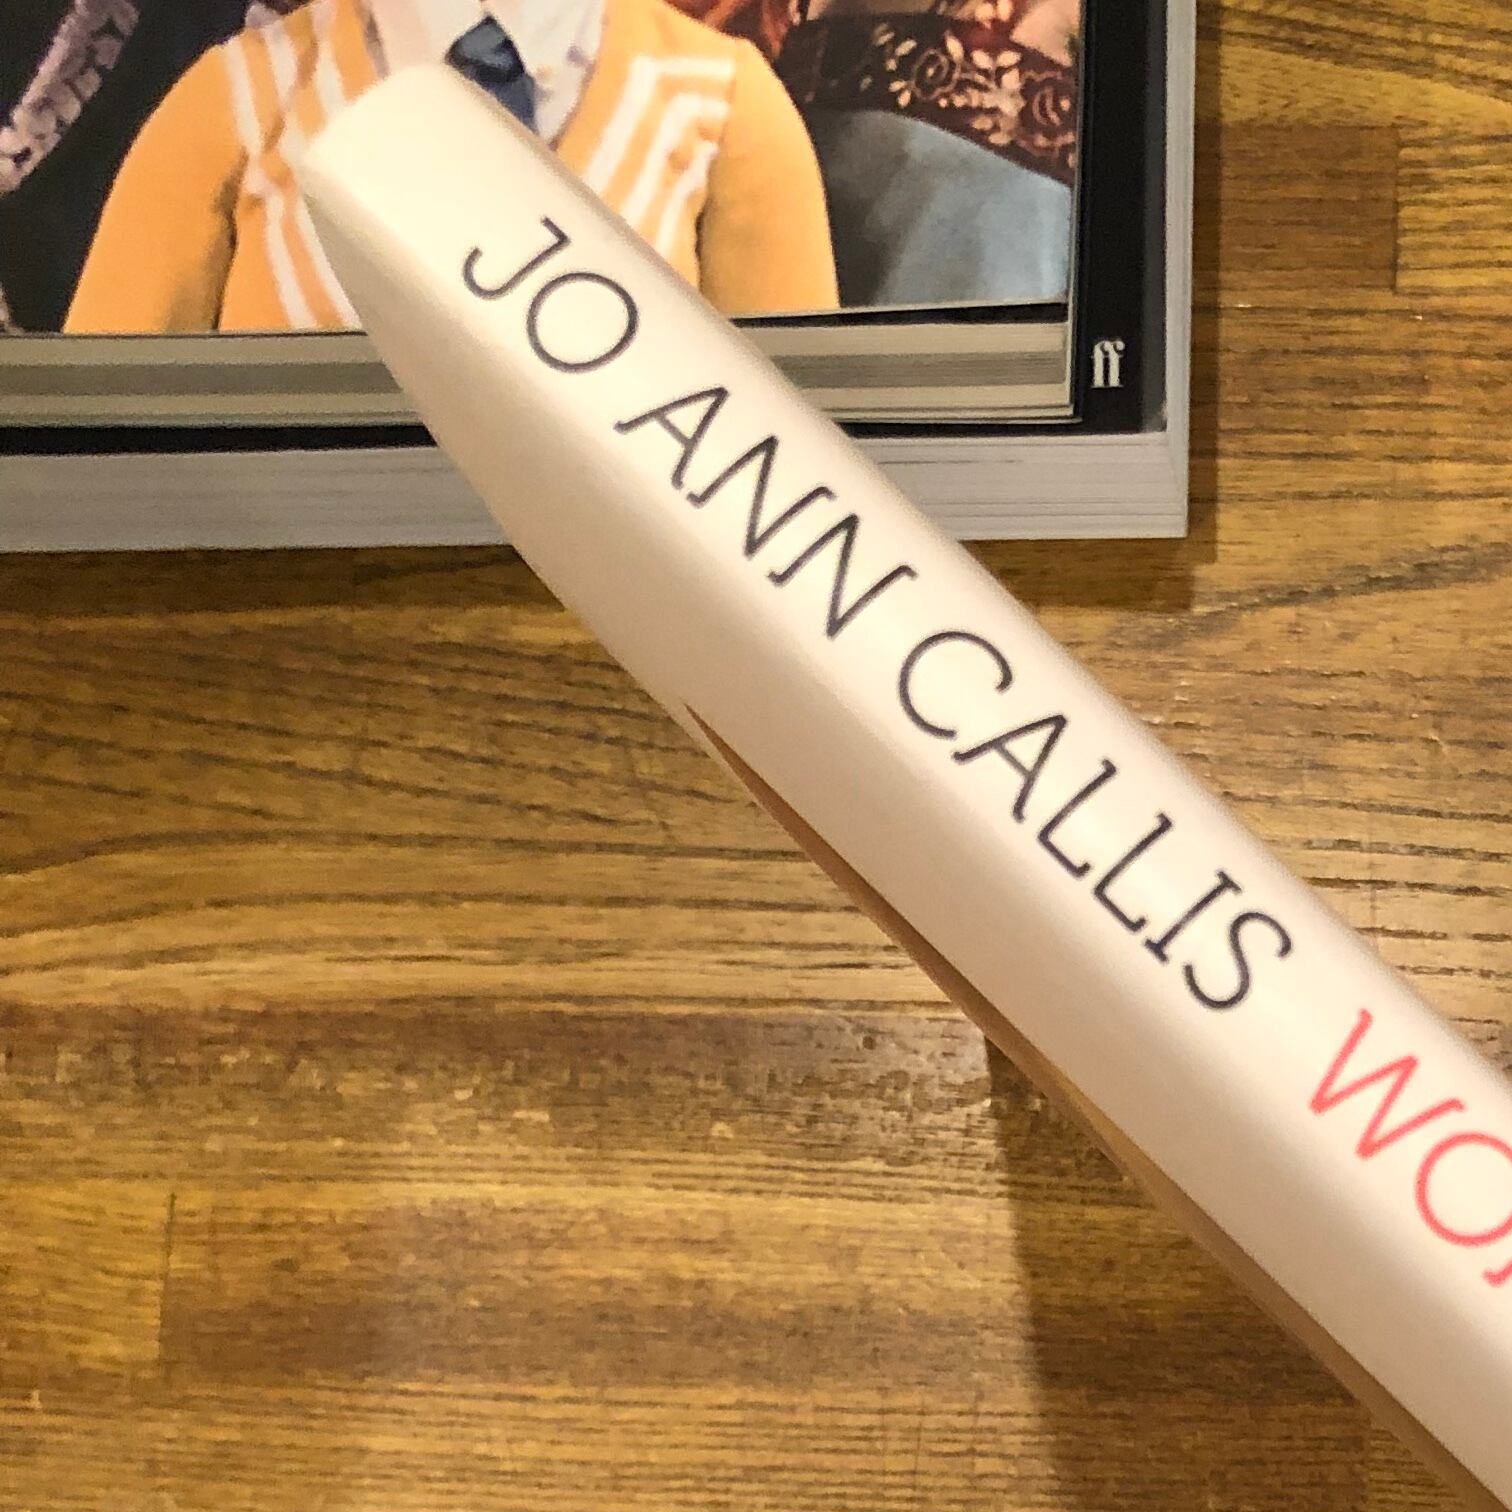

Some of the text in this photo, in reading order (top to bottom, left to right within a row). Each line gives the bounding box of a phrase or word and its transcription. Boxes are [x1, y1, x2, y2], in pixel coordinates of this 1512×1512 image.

[1090, 340, 1126, 389] ff
[462, 218, 638, 374] JO
[613, 383, 915, 637] ANN
[898, 628, 1294, 1012] CALLIS
